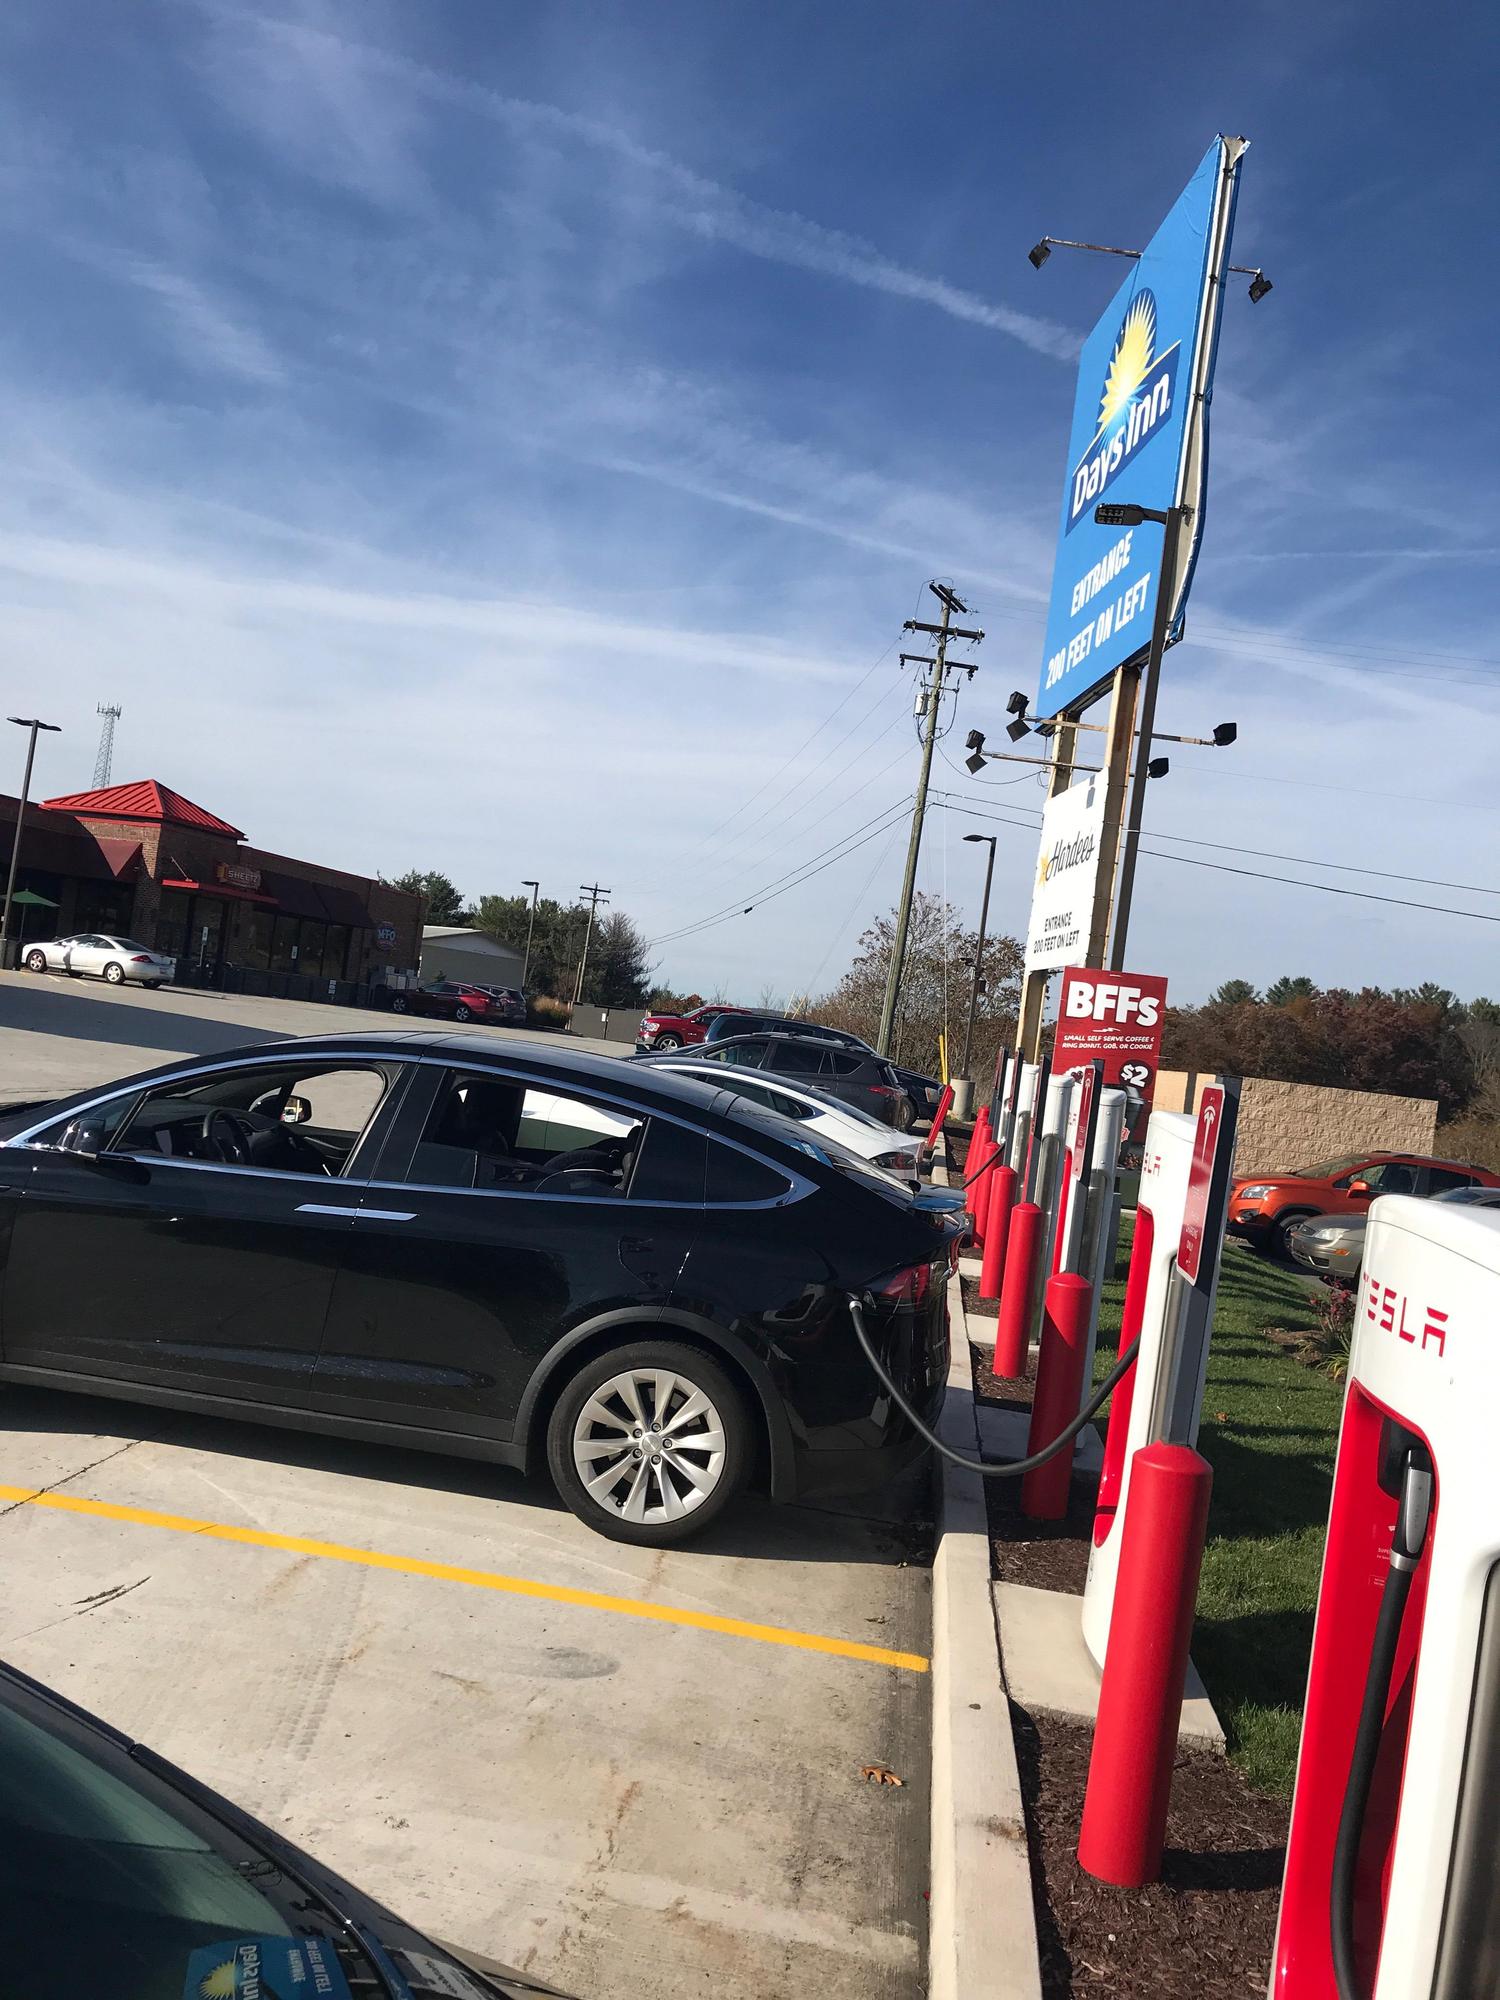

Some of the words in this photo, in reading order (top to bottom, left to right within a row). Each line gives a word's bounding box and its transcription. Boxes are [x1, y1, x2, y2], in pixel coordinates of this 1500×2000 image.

[1072, 425, 1126, 519] Days
[1070, 528, 1134, 618] ENTRANCE
[1045, 647, 1066, 690] 200
[1066, 620, 1095, 673] FEET
[1094, 604, 1114, 648] ON
[1114, 571, 1151, 633] LEFT
[1033, 938, 1044, 954] 200
[1043, 935, 1057, 951] FEET
[1056, 932, 1066, 949] ON
[1065, 929, 1080, 947] LEFT
[1044, 911, 1073, 932] ENTRANCE
[1065, 980, 1160, 1027] BFFs
[1121, 1063, 1149, 1087] $2
[1363, 1272, 1448, 1358] TESLA
